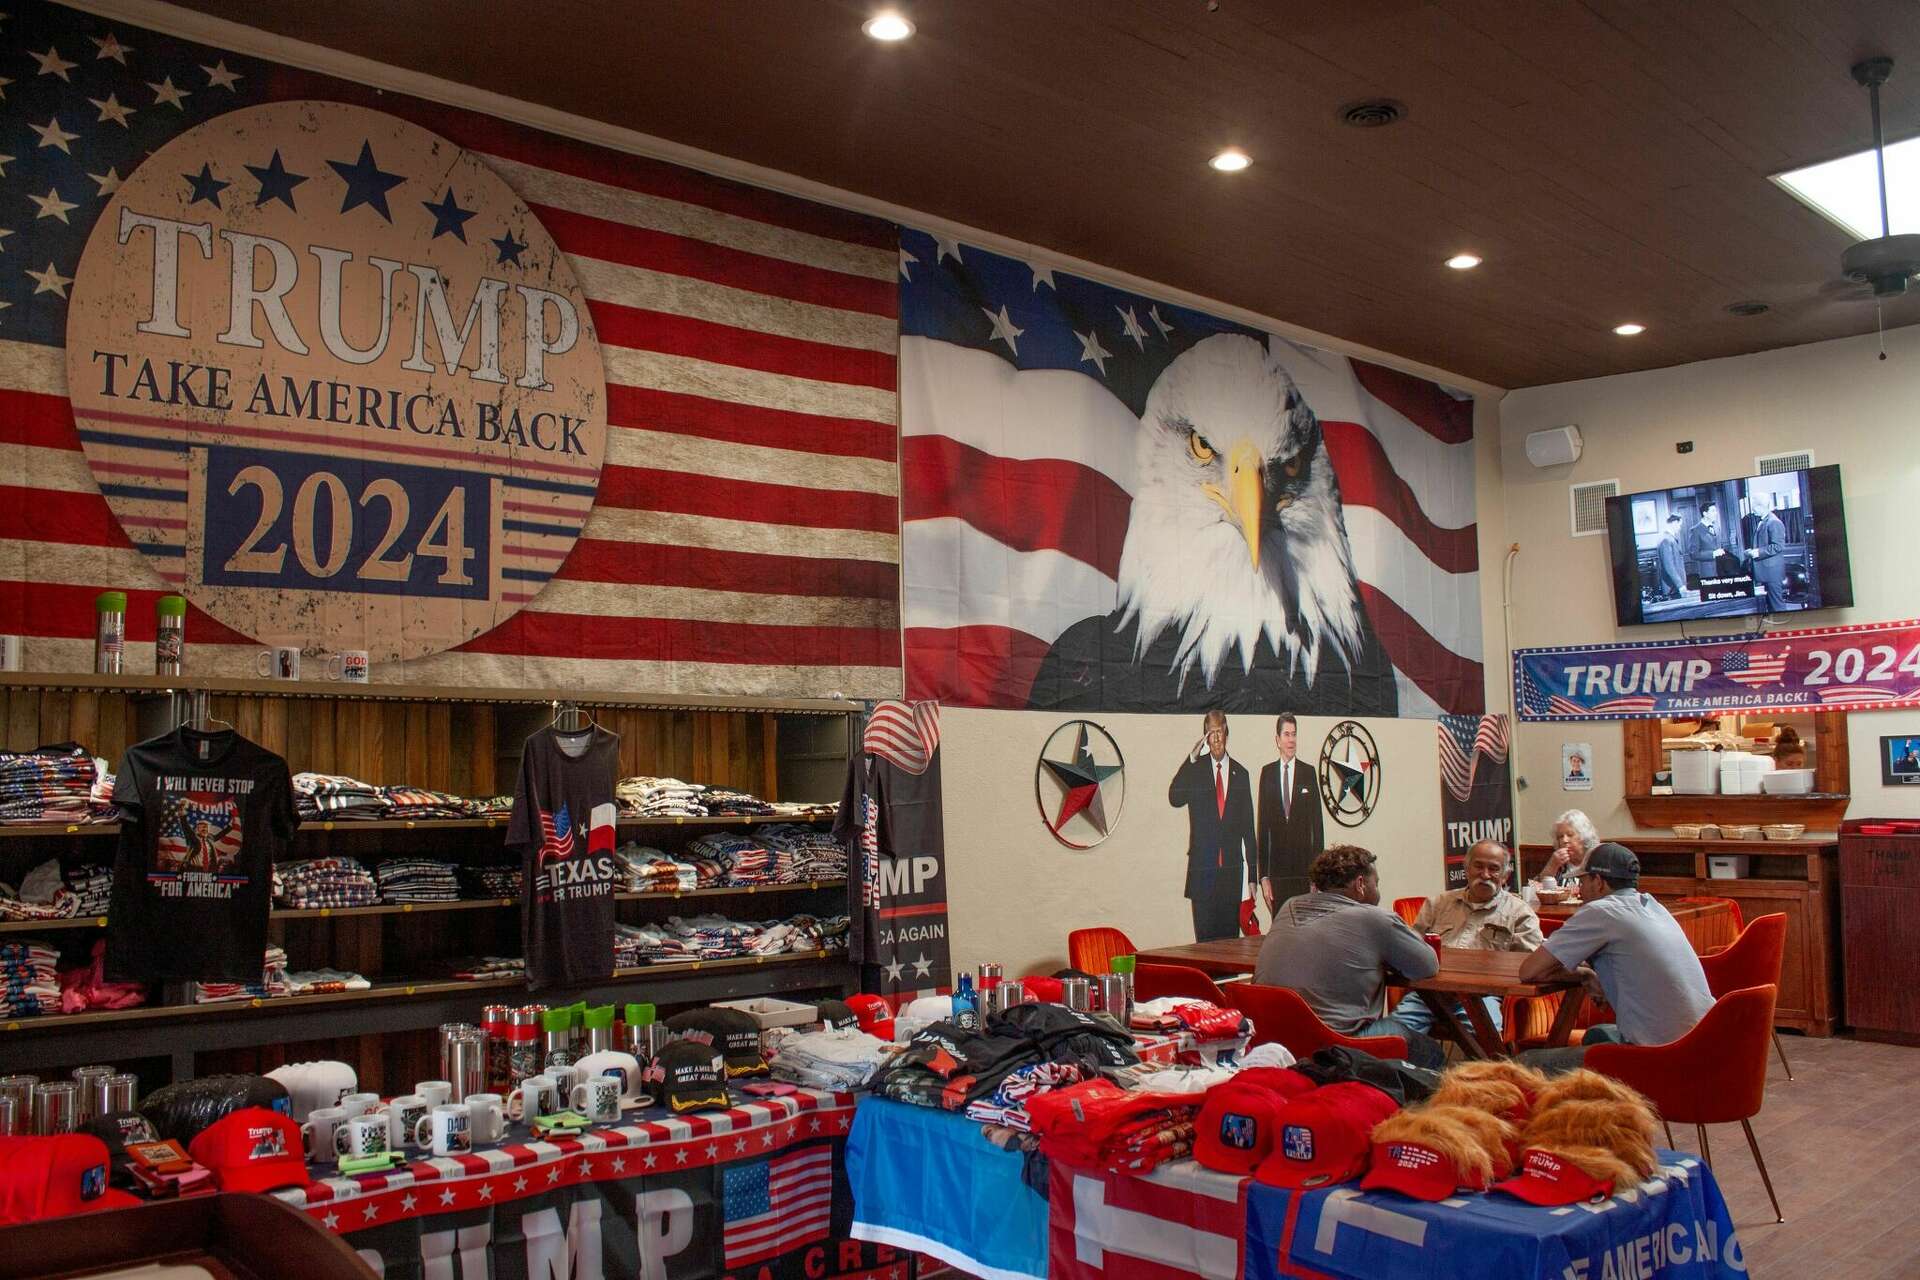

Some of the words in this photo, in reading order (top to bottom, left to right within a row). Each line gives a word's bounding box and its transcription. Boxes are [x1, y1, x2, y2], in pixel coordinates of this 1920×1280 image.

[117, 206, 580, 392] TRUMP
[93, 350, 234, 411] TAKE
[245, 371, 464, 439] AMERICA
[475, 403, 589, 456] BACK
[223, 464, 477, 586] 2024
[1700, 578, 1721, 586] Thanks
[1721, 577, 1734, 585] very
[345, 656, 367, 666] GOD
[1563, 659, 1712, 697] TRUMP
[1803, 643, 1920, 686] 2024
[1667, 696, 1701, 709] TAKE
[1703, 694, 1763, 708] AMERICA
[1766, 691, 1808, 704] BACK!
[156, 776, 162, 790] I
[164, 776, 187, 791] WILL
[190, 777, 225, 793] NEVER
[228, 778, 255, 794] STOP
[1447, 818, 1511, 848] TRUMP
[182, 871, 213, 882] FIGHTING
[544, 857, 614, 888] TEXAS
[1449, 869, 1467, 881] SAVE
[567, 881, 612, 899] TRUMP
[898, 923, 945, 944] AGAIN
[674, 1065, 693, 1076] MAKE
[677, 1073, 699, 1083] GREAT
[1529, 1155, 1561, 1171] TRUMP
